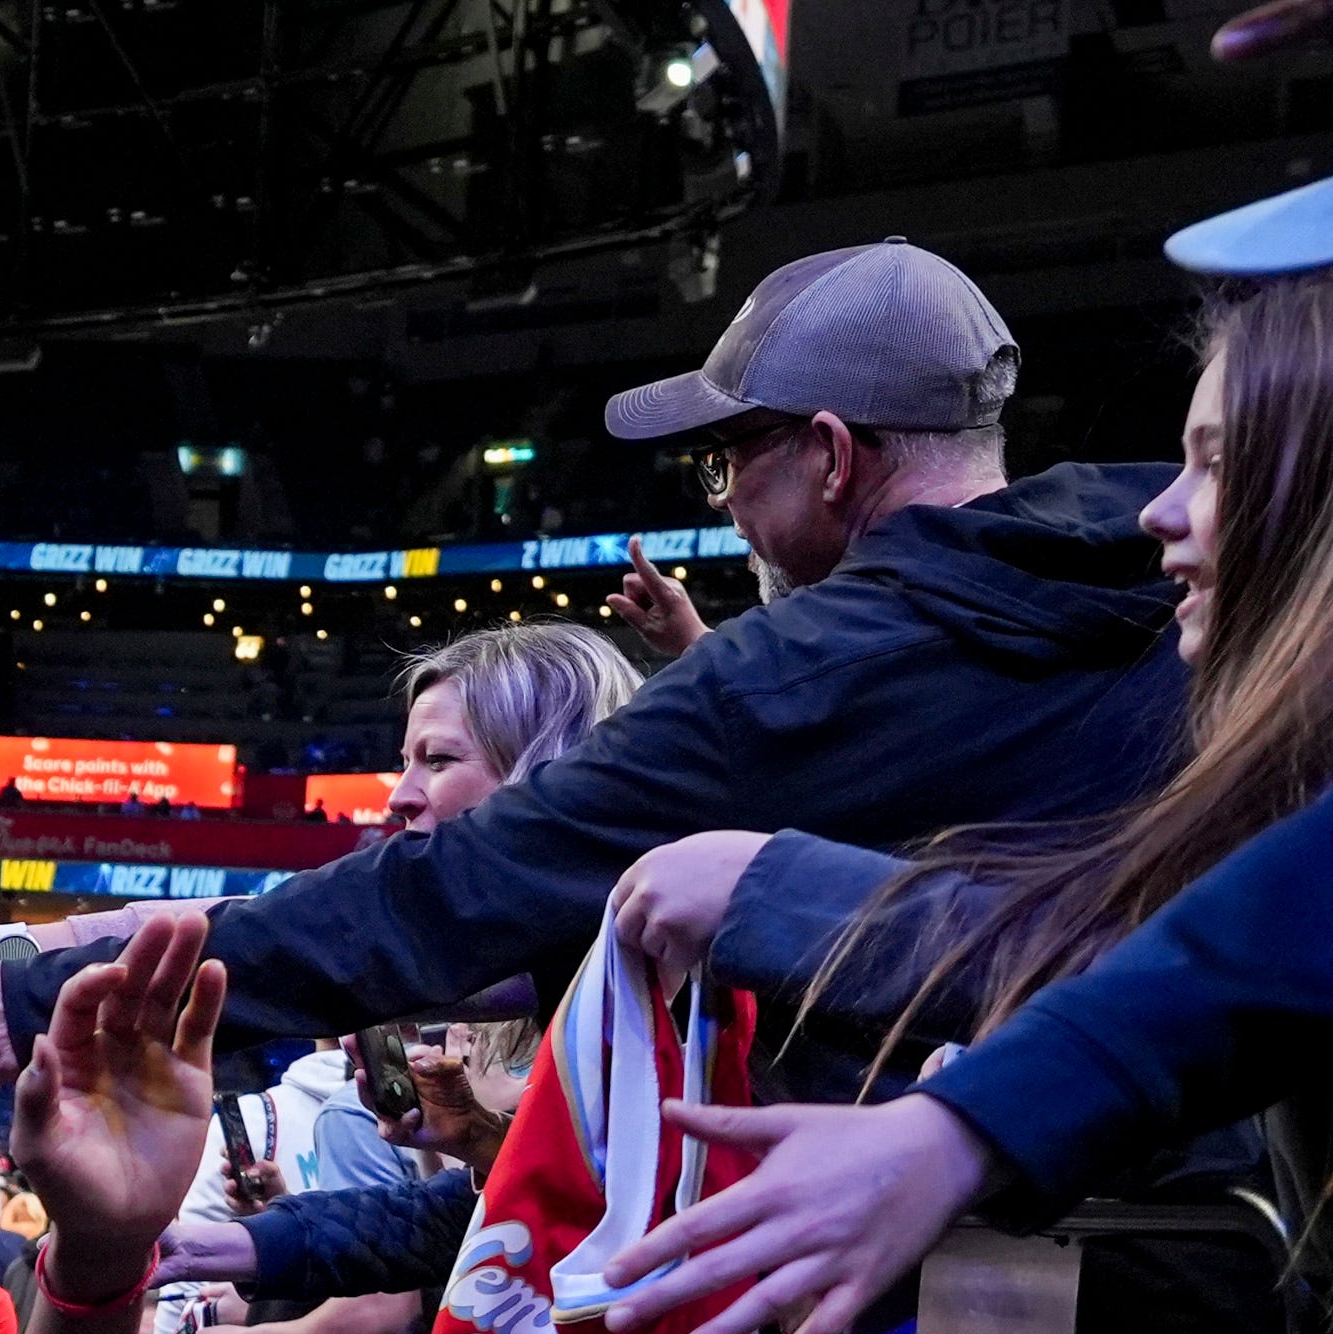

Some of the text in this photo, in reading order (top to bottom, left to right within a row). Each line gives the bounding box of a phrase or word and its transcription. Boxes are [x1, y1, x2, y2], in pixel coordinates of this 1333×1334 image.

[31, 542, 142, 573] GRIZZ WIN
[178, 547, 291, 579] GRIZZ WIN
[324, 547, 440, 581] GRIZZ WIN
[539, 537, 590, 567] WIN
[23, 754, 168, 776] Score points with
[16, 776, 44, 792] the
[143, 781, 179, 800] App
[0, 858, 56, 892] WIN
[169, 869, 225, 897] WIN
